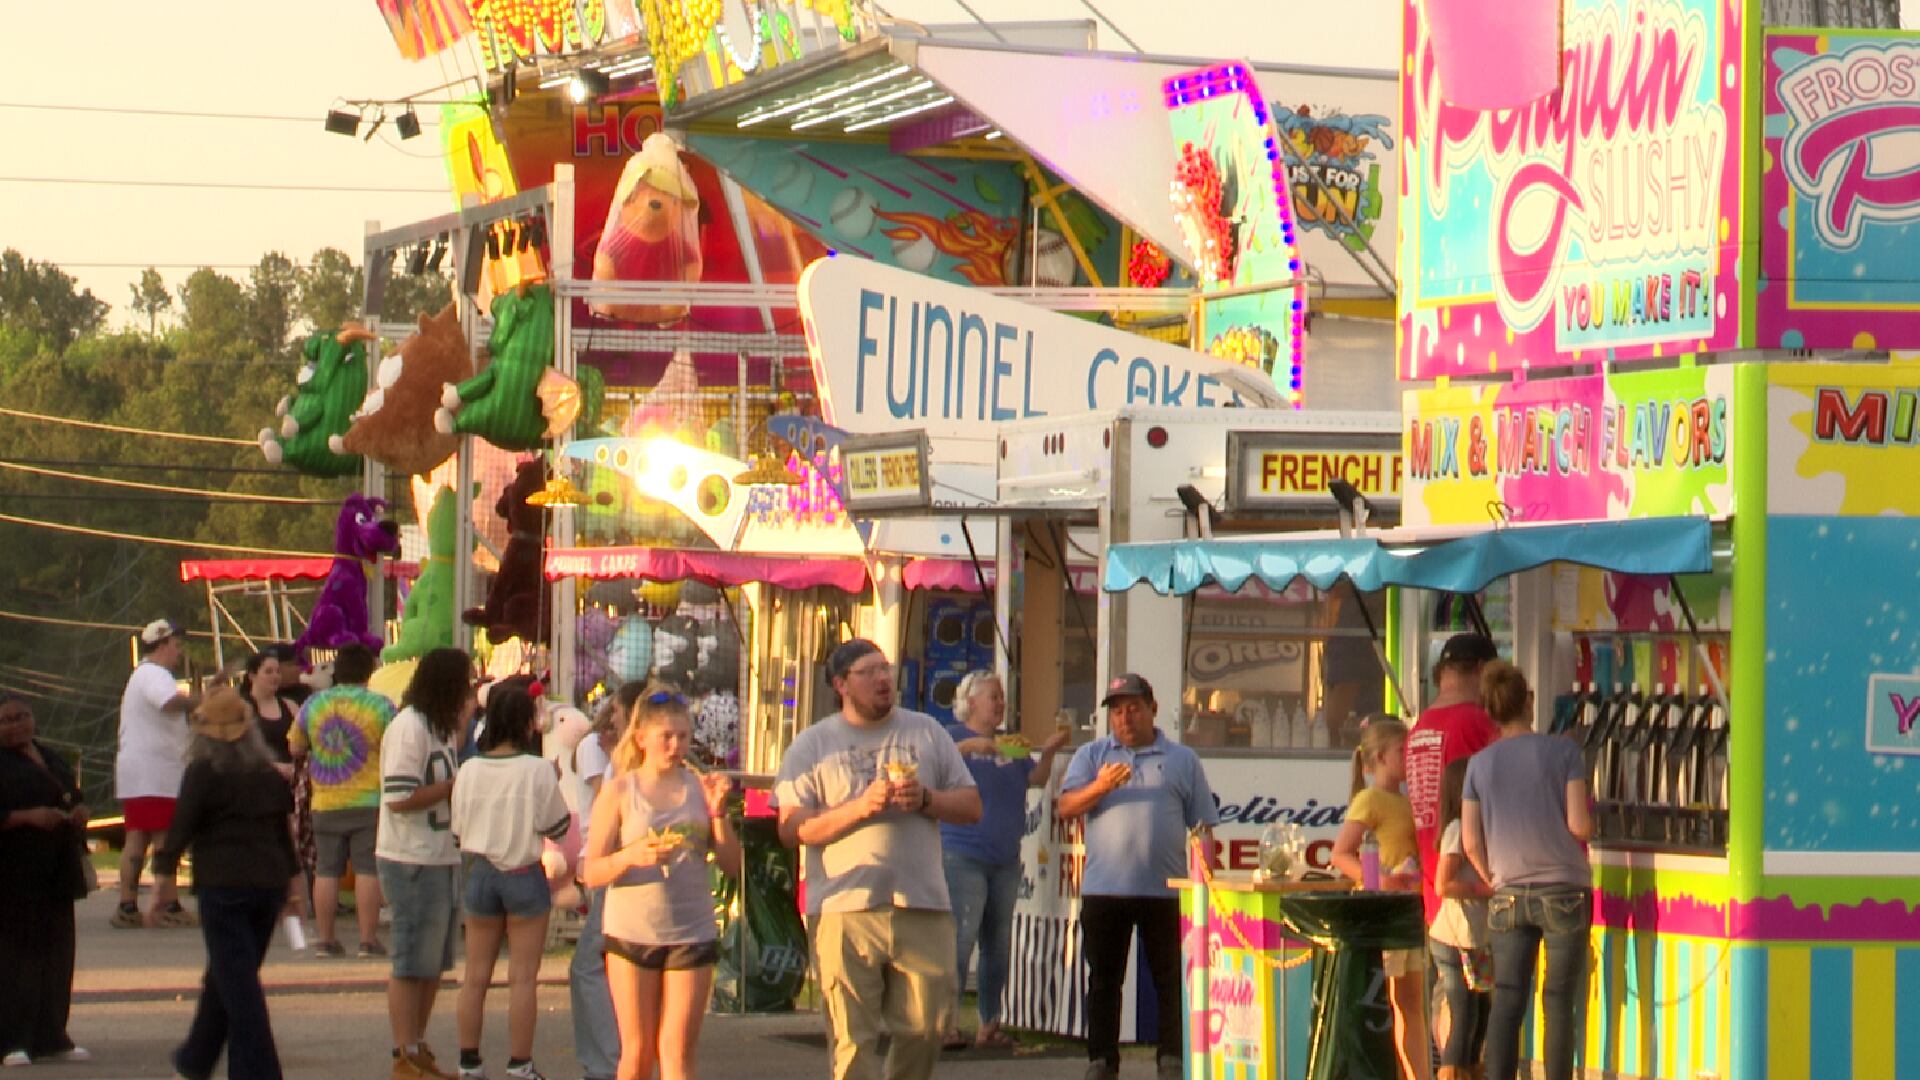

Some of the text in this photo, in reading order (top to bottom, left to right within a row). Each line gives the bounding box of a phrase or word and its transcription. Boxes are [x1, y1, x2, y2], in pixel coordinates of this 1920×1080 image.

[1792, 55, 1920, 122] FROS
[1287, 164, 1360, 191] UST FOR
[1294, 184, 1358, 225] UN
[1589, 131, 1717, 243] SLUSHY
[1562, 267, 1709, 331] YOU MAKE IT!
[855, 288, 1048, 421] FUNNEL
[1410, 396, 1728, 480] MIX & MATCH FLAVORS
[1815, 389, 1920, 445] MI
[1262, 453, 1383, 492] FRENCH
[1192, 639, 1300, 680] OREO
